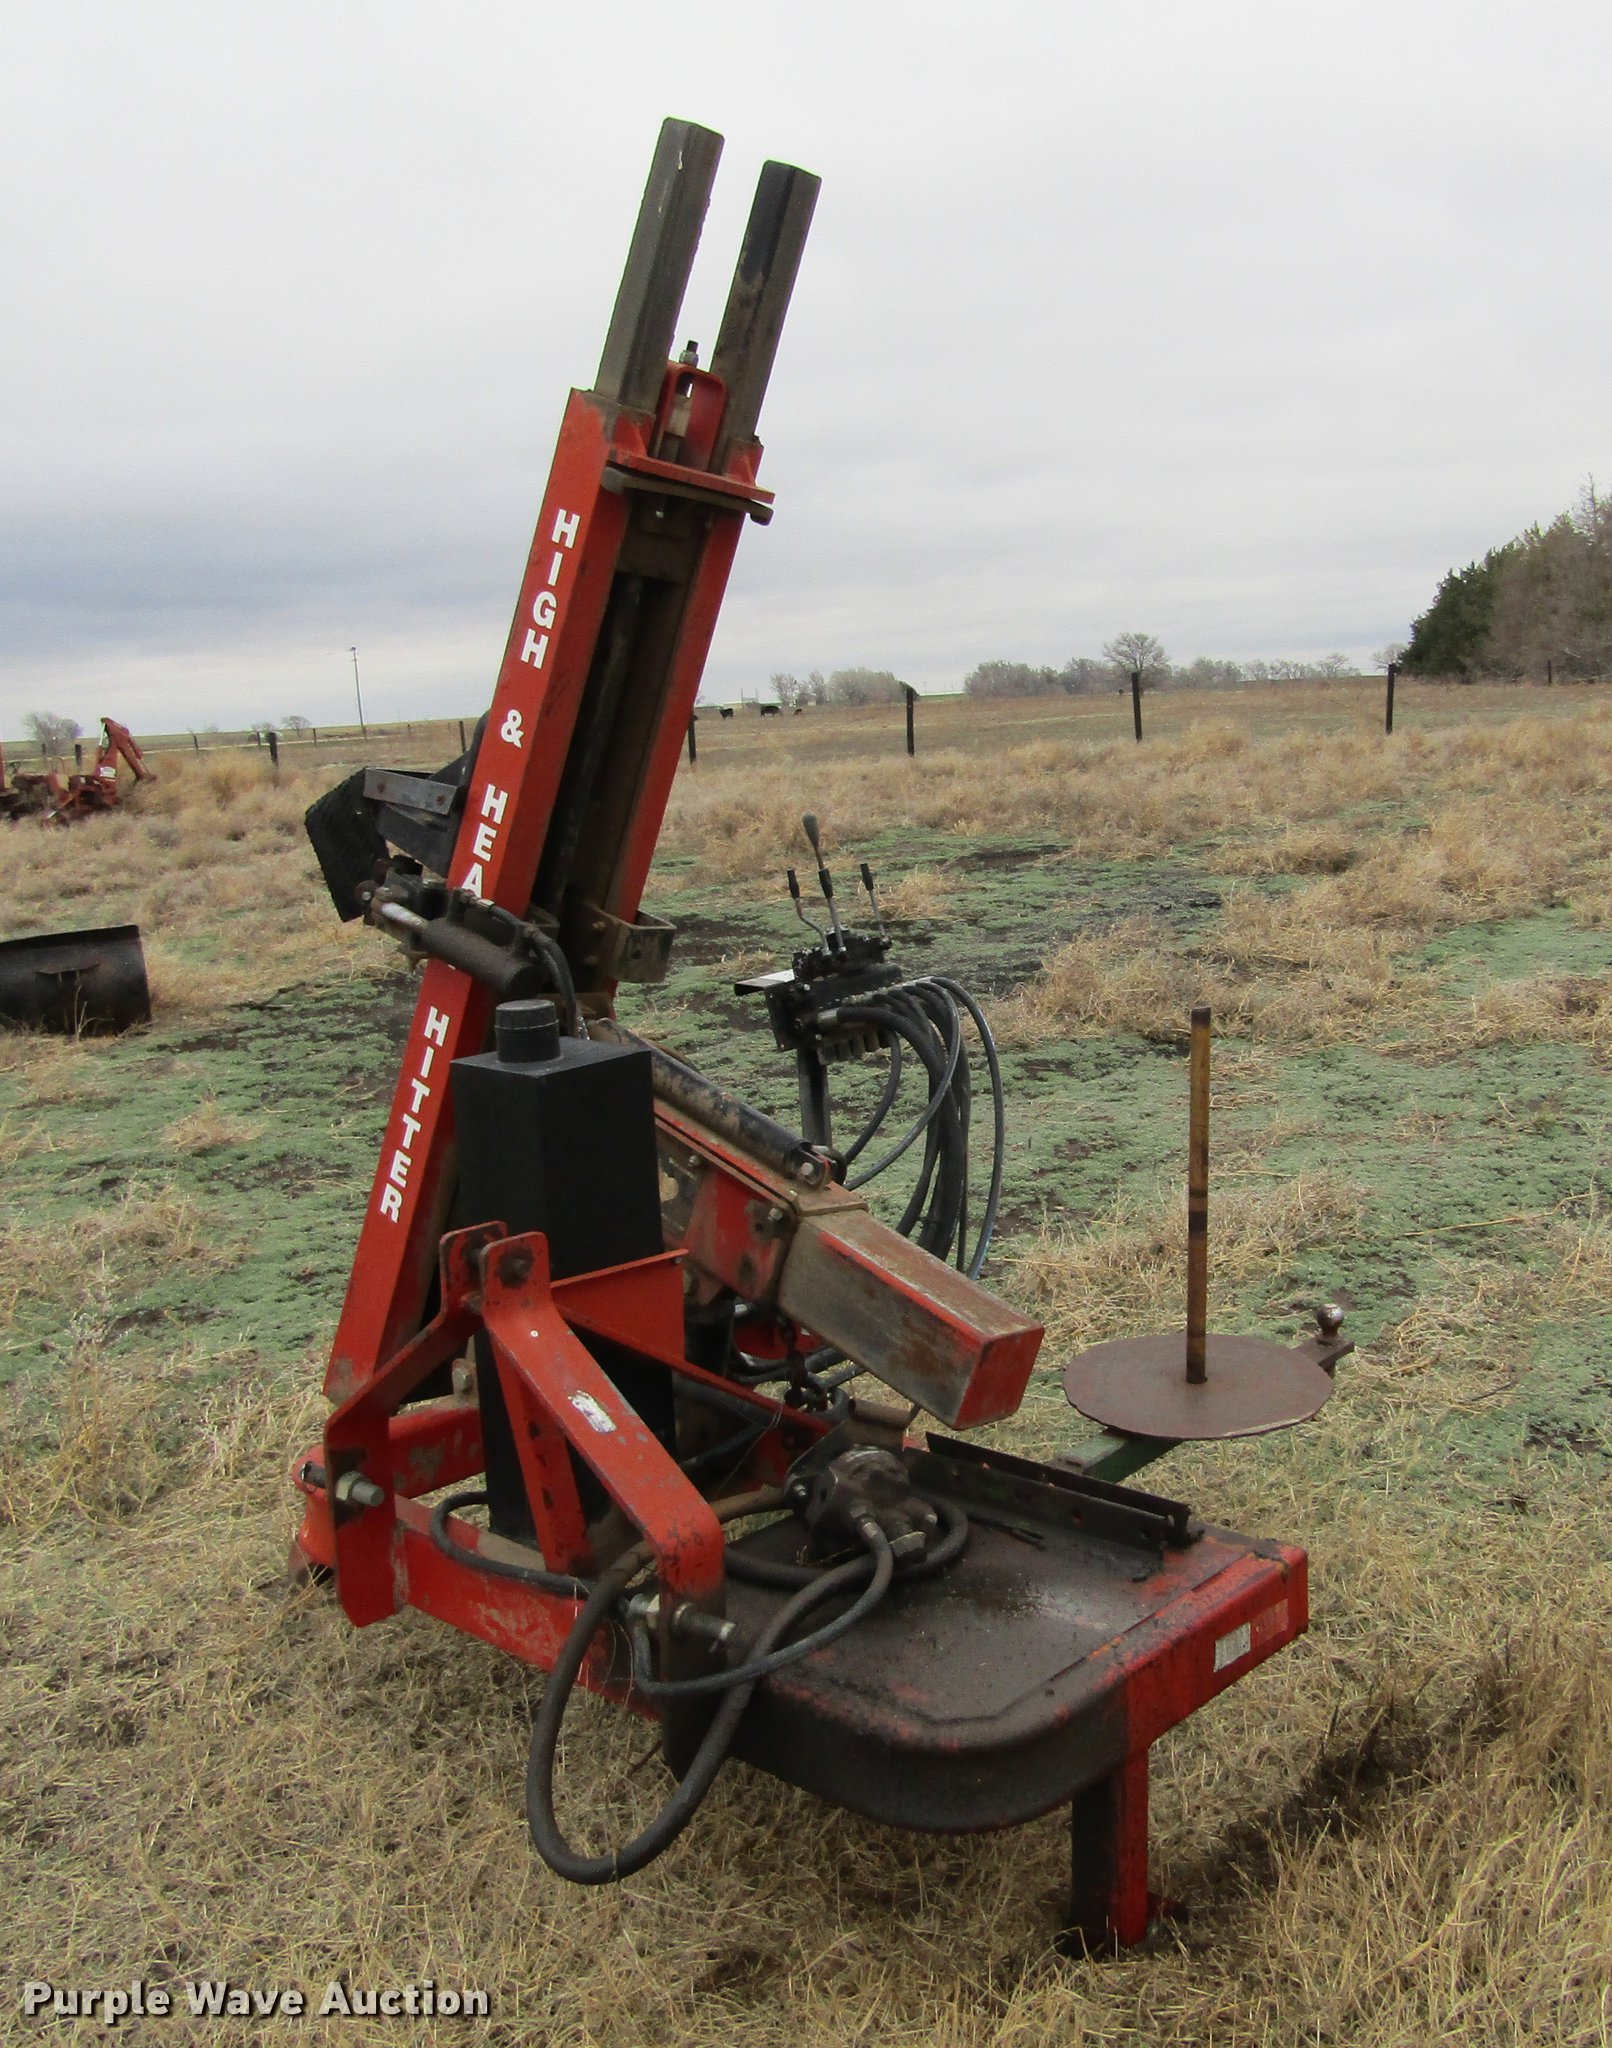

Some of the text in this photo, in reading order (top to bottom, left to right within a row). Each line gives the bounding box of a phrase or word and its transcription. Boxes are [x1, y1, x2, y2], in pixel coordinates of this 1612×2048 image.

[520, 508, 581, 670] HIGH
[500, 708, 525, 749] &
[379, 1006, 450, 1224] HITTER
